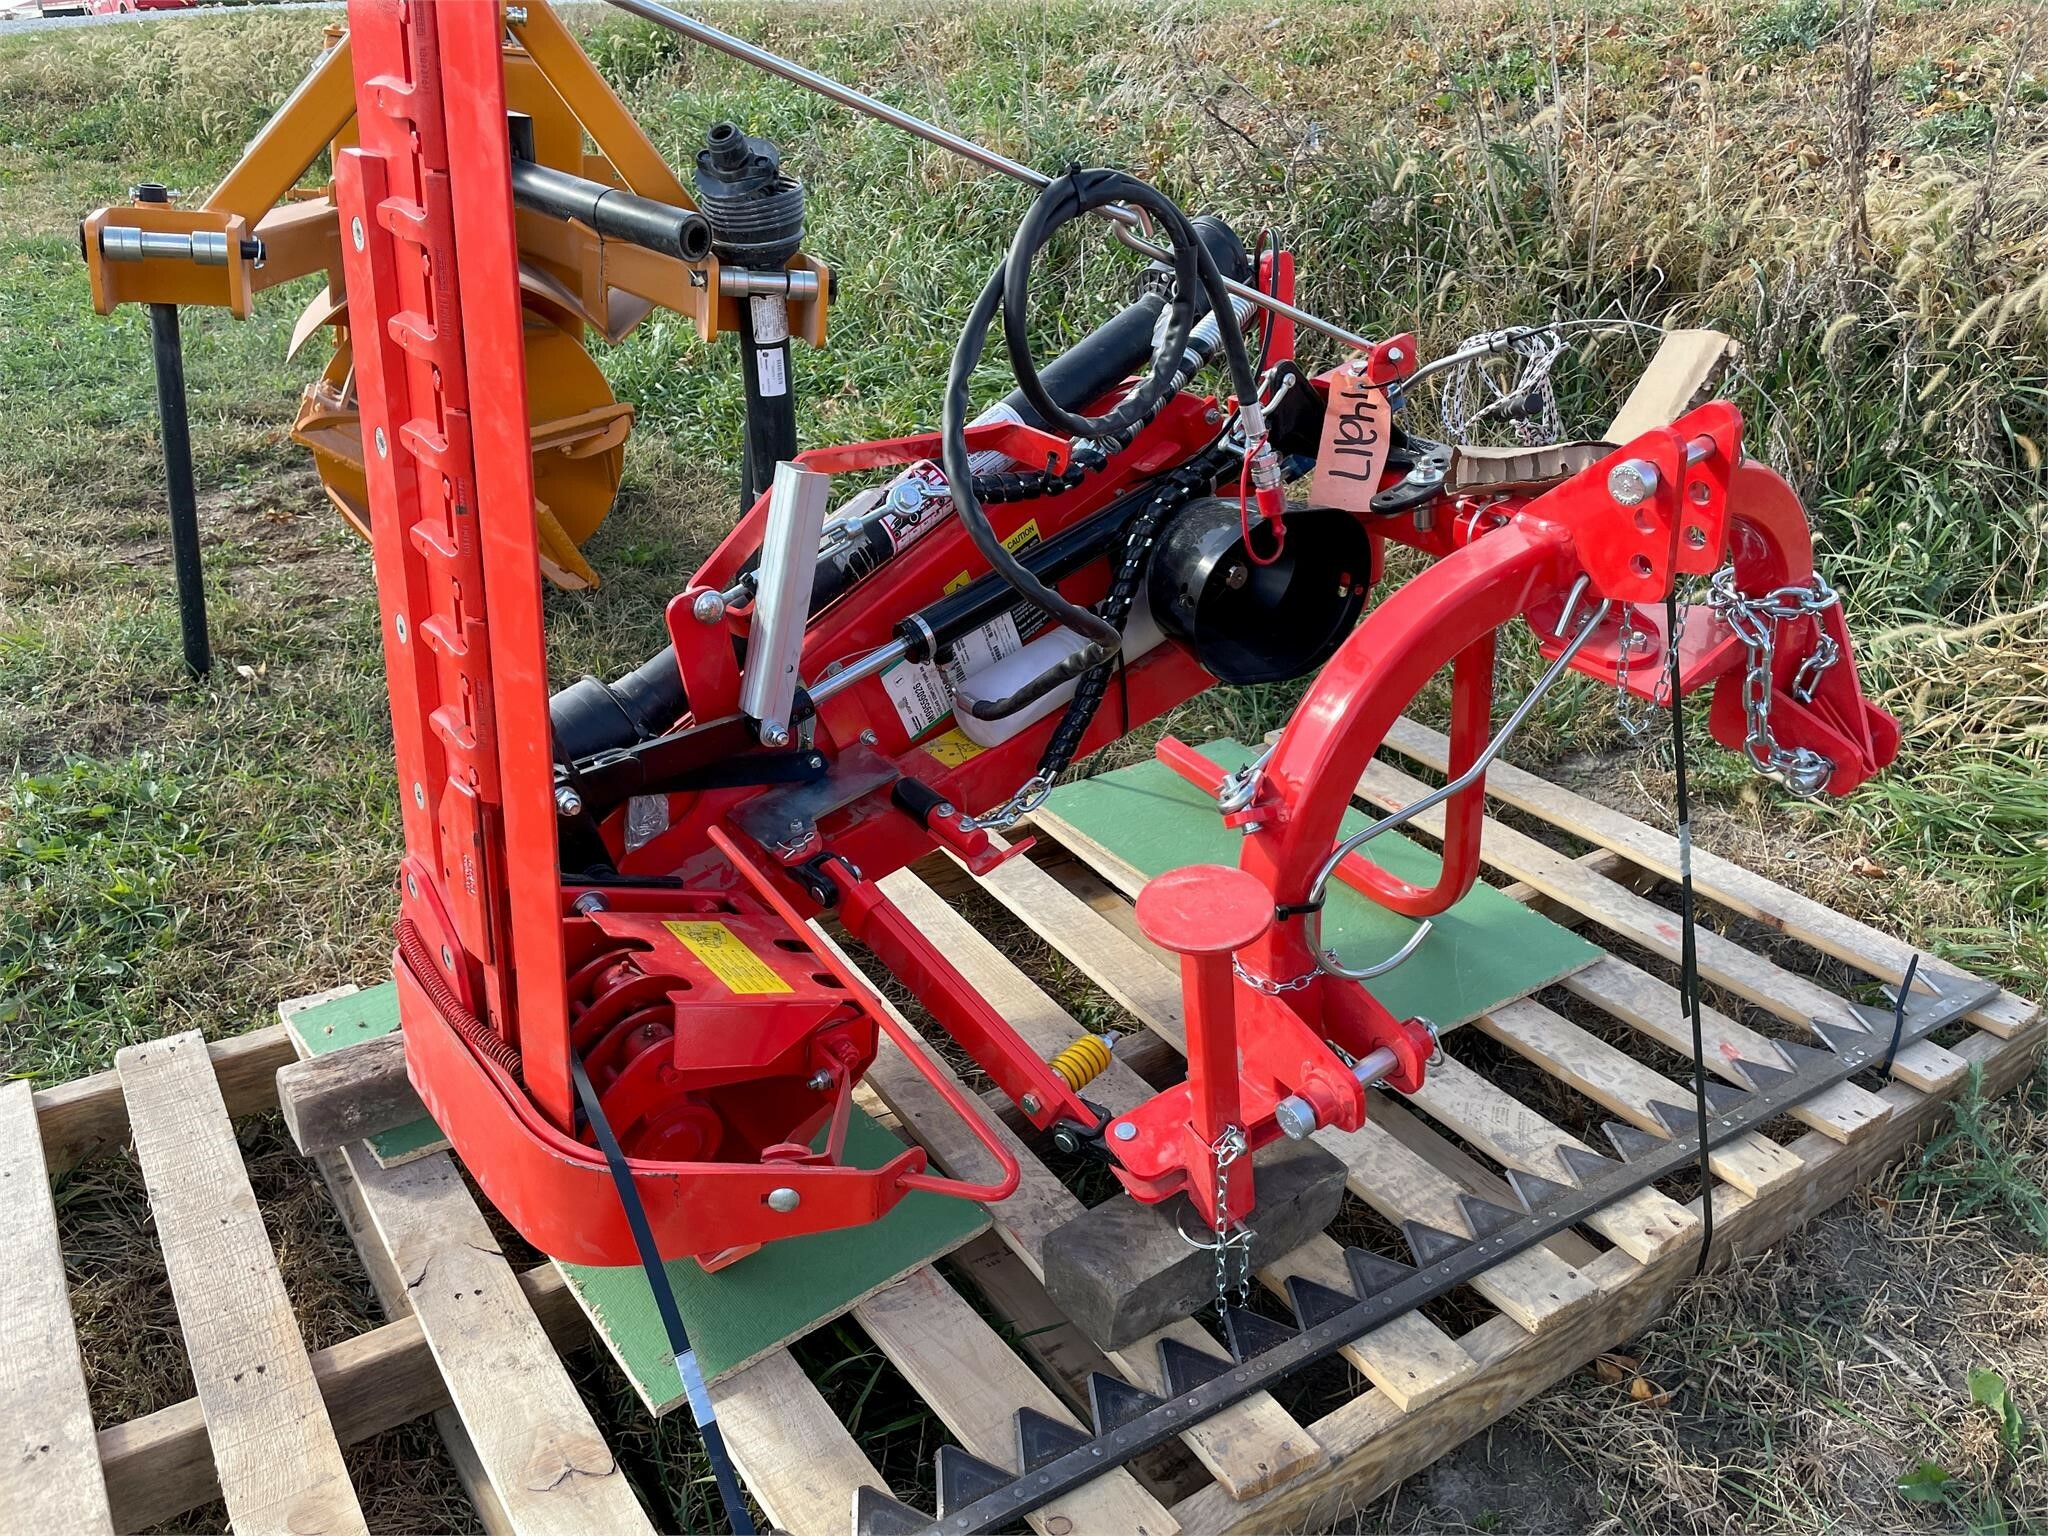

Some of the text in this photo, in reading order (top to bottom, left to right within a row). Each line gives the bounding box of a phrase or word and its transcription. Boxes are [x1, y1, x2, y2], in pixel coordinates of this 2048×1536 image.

[1328, 392, 1377, 481] 14217
[1007, 524, 1035, 549] CAUTION
[913, 682, 936, 723] M99556026
